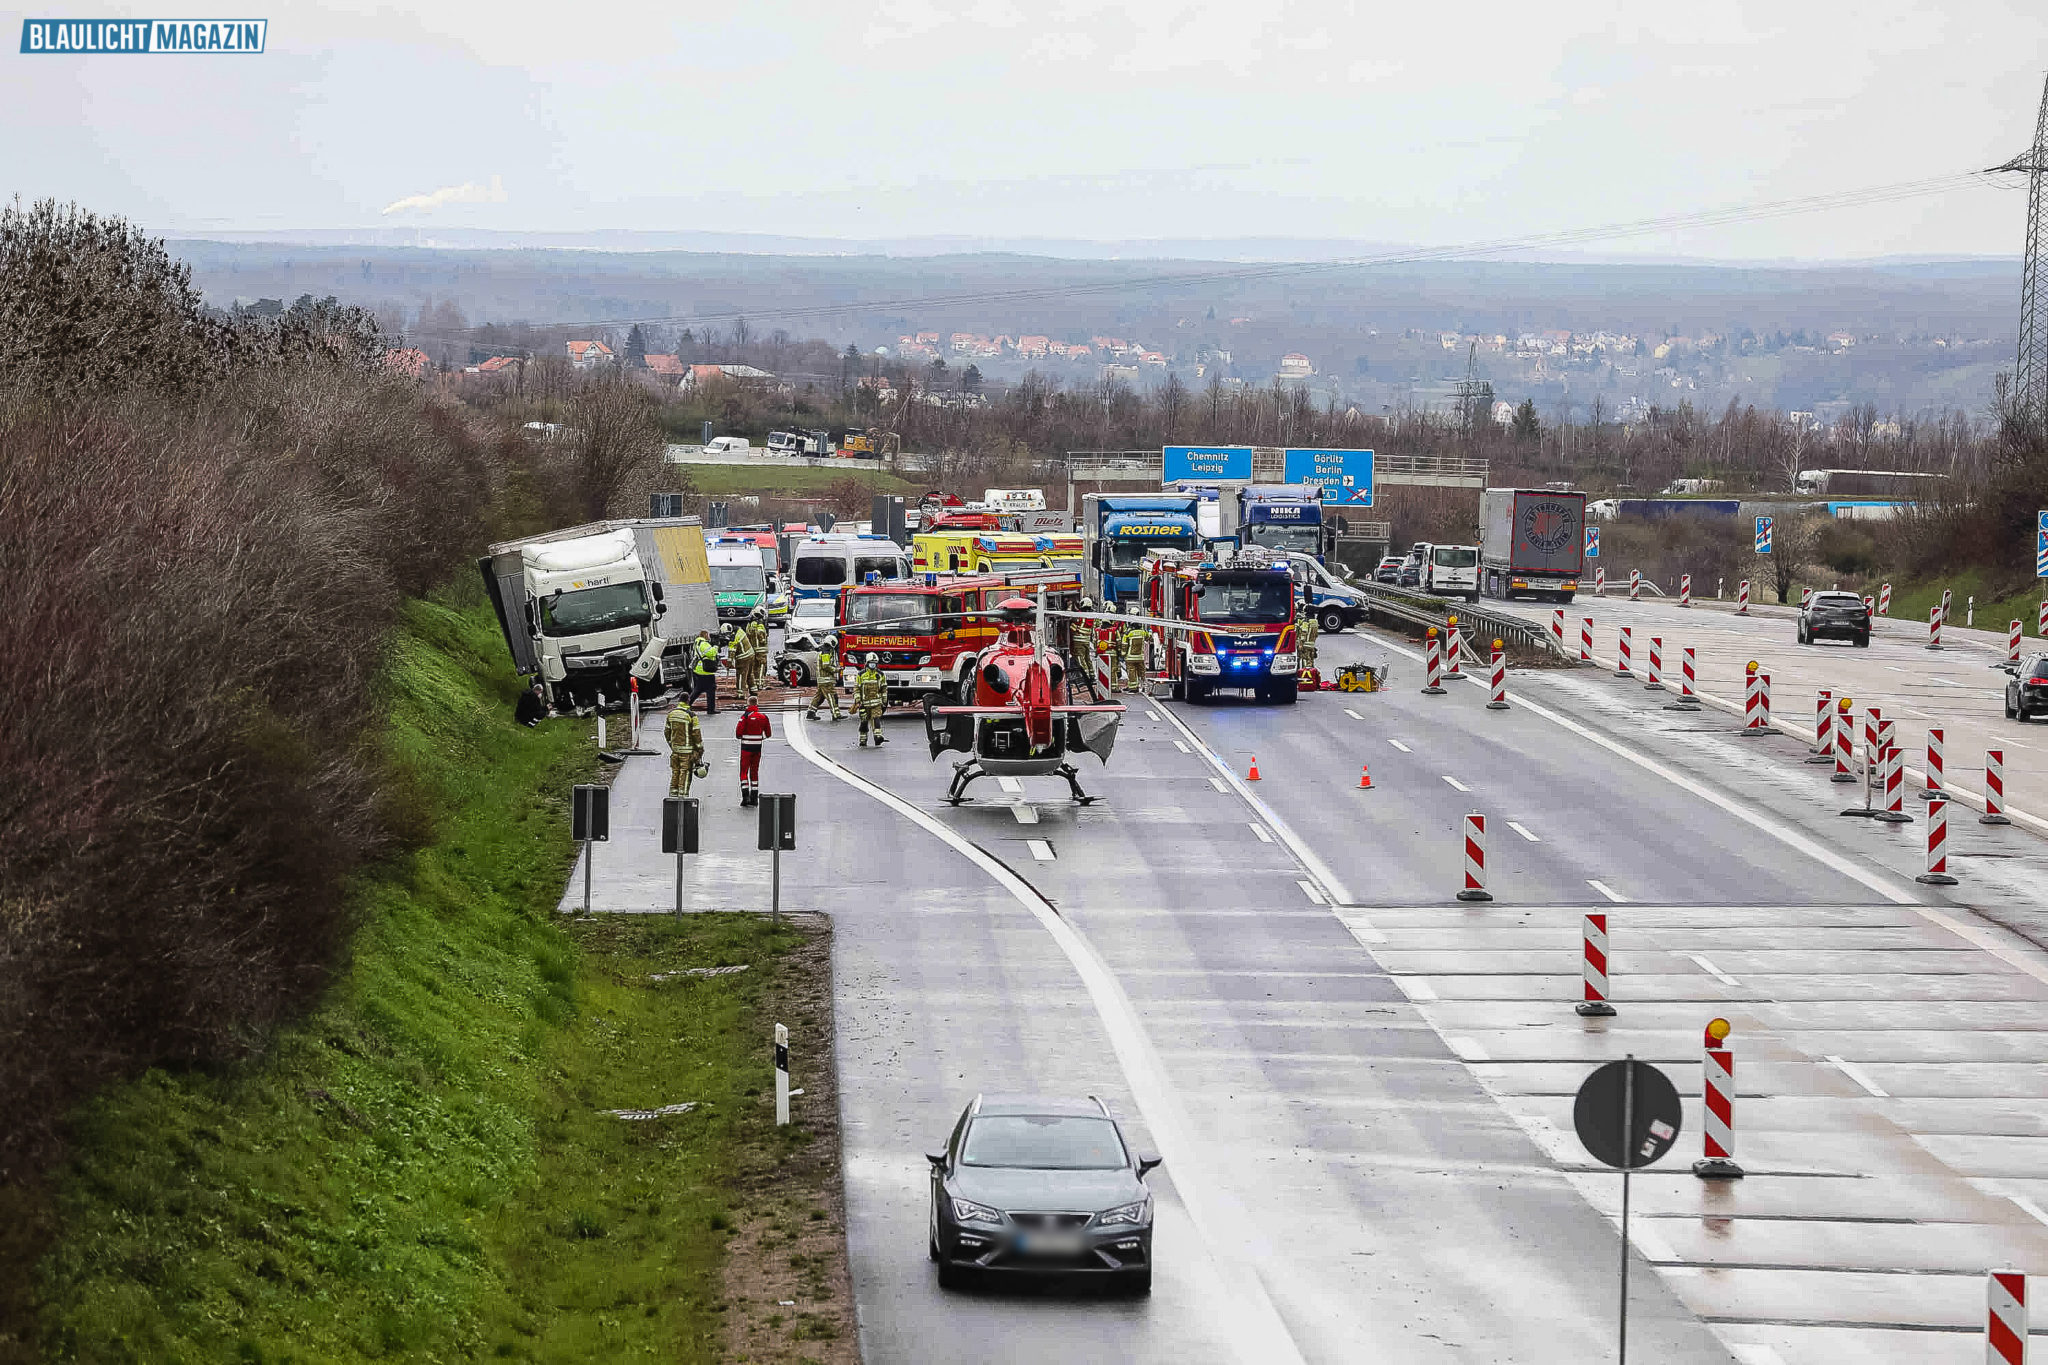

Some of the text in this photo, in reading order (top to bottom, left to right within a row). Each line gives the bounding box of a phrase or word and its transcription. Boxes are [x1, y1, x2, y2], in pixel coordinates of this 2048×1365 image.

[1187, 451, 1229, 461] Chemnitz
[1314, 454, 1344, 463] Görlitz
[1192, 463, 1223, 473] Leipzig
[1315, 465, 1342, 474] Berlin
[1303, 475, 1340, 485] Dresden
[1034, 517, 1064, 526] Metz
[1205, 572, 1212, 580] 2
[587, 576, 610, 587] hartl
[856, 636, 917, 646] FEUERWEHR
